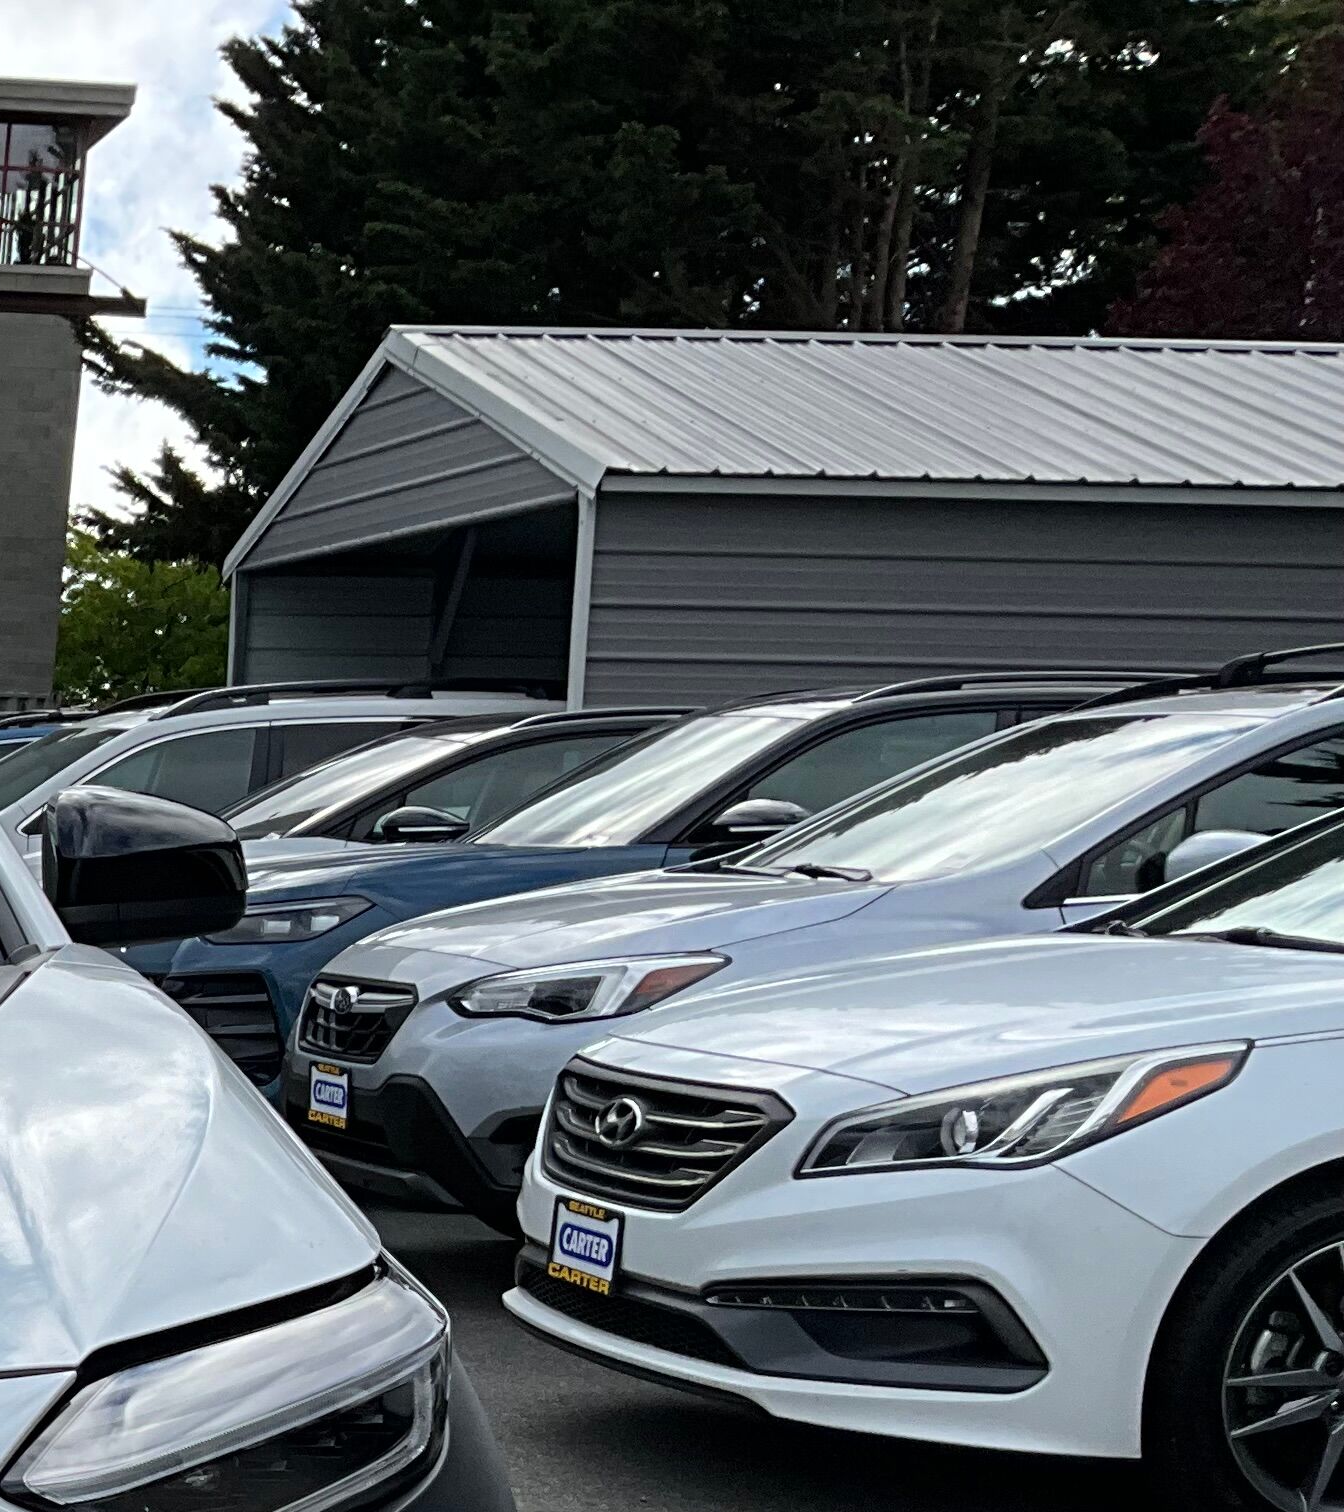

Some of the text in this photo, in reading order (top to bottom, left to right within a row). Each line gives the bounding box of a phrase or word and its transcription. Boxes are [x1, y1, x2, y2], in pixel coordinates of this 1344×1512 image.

[315, 1082, 344, 1105] CARTER
[308, 1109, 346, 1129] CARTER
[568, 1200, 605, 1219] SEATTLE
[562, 1227, 609, 1262] CARTER
[548, 1262, 610, 1295] CARTER
